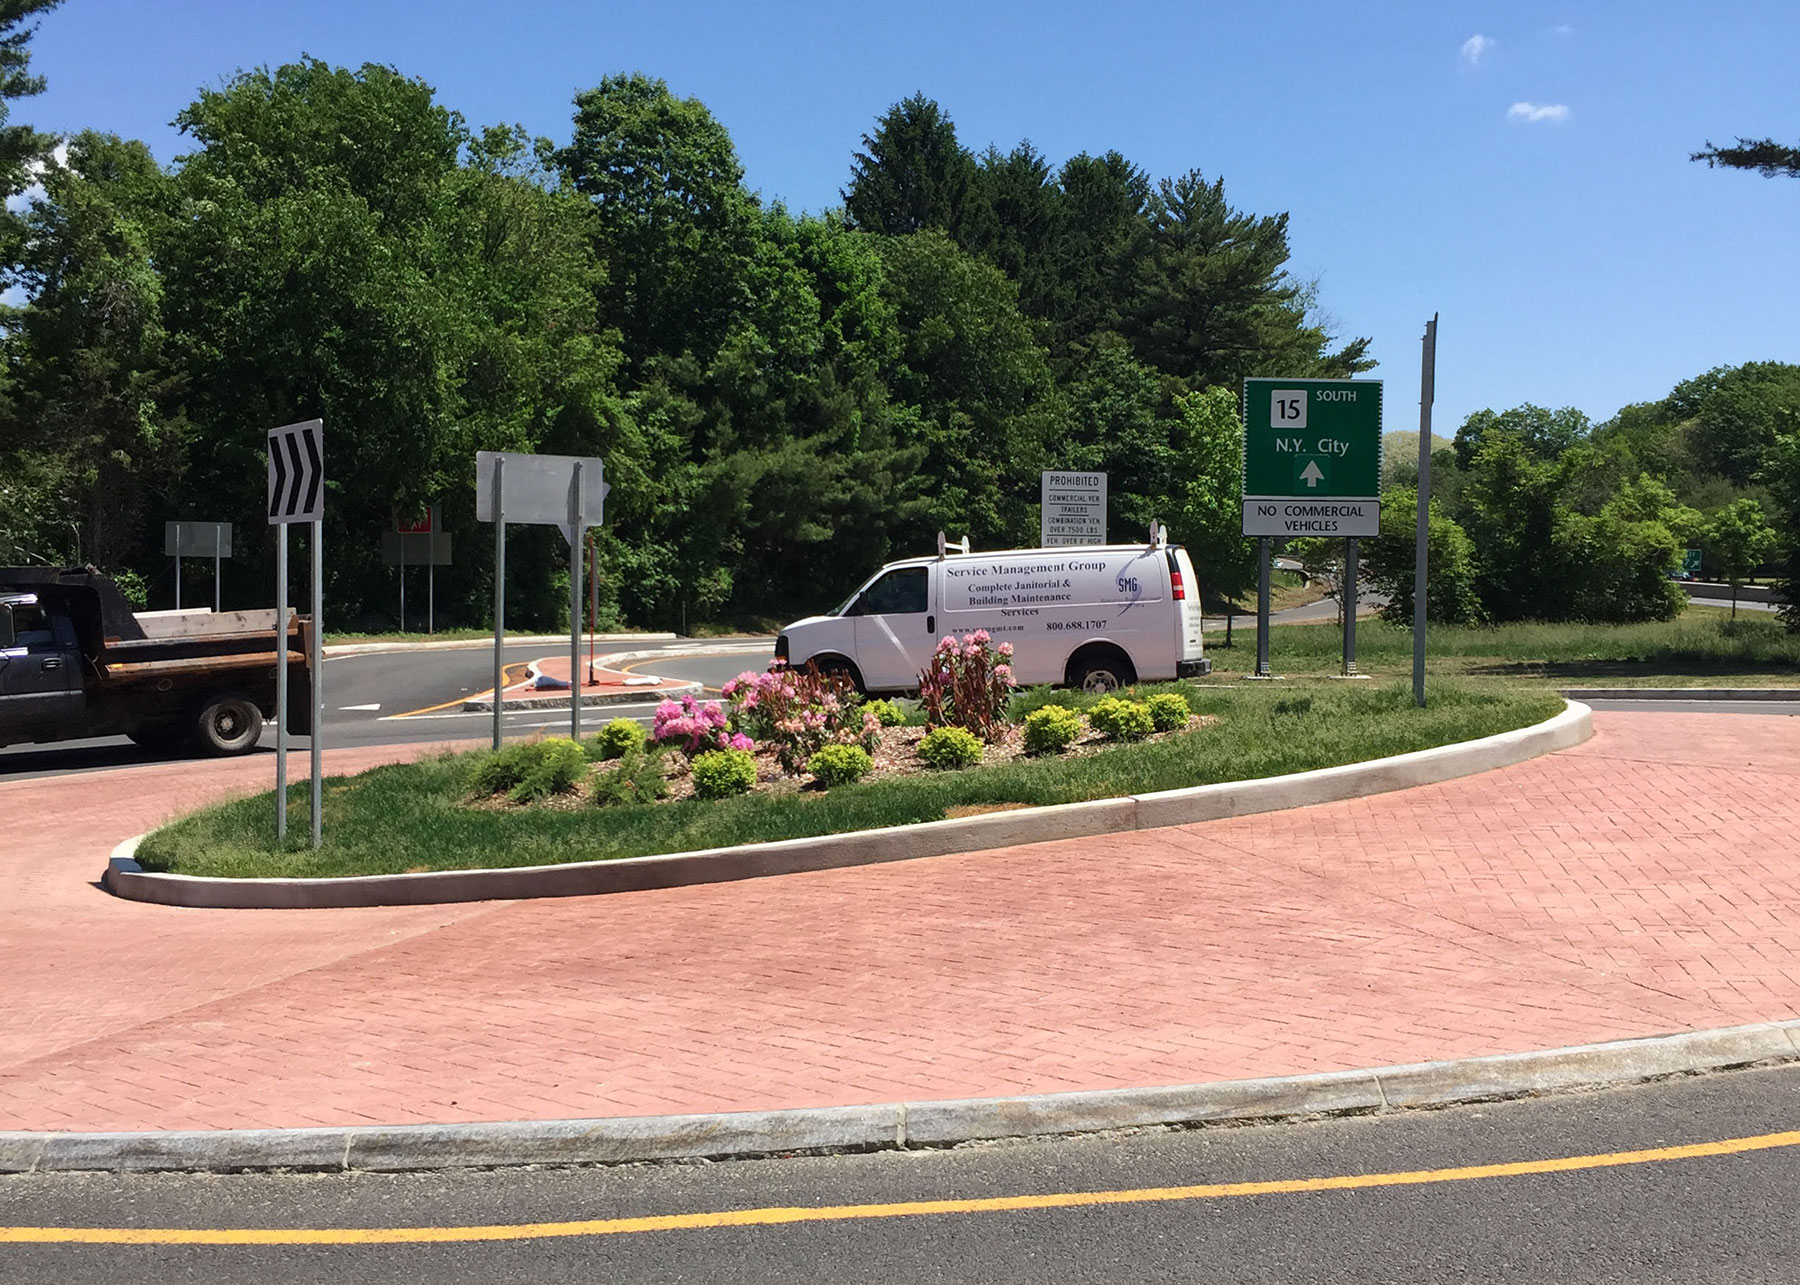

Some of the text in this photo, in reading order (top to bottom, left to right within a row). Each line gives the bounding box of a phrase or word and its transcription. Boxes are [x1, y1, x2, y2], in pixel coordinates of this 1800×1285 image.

[1316, 390, 1357, 402] SOUTH
[1276, 399, 1301, 420] 15
[1276, 438, 1350, 457] N.Y. City
[1050, 476, 1099, 486] PROHIBITED
[1048, 494, 1100, 503] COMMERCIAL VEH
[1061, 506, 1088, 514] TRAILERS
[1257, 505, 1364, 517] NO COMMERCIAL
[1048, 517, 1087, 525] COMBINATION
[1284, 520, 1338, 532] VEHICLES
[1049, 526, 1065, 534] OVER
[1068, 526, 1084, 534] 7500
[947, 561, 1106, 577] Service Management Group
[968, 578, 1071, 593] Complete Janitorial &
[1118, 577, 1138, 593] SMG
[969, 593, 1072, 606] Building Maintenance
[1000, 608, 1039, 617] Services
[1046, 620, 1107, 631] 800.688.1707
